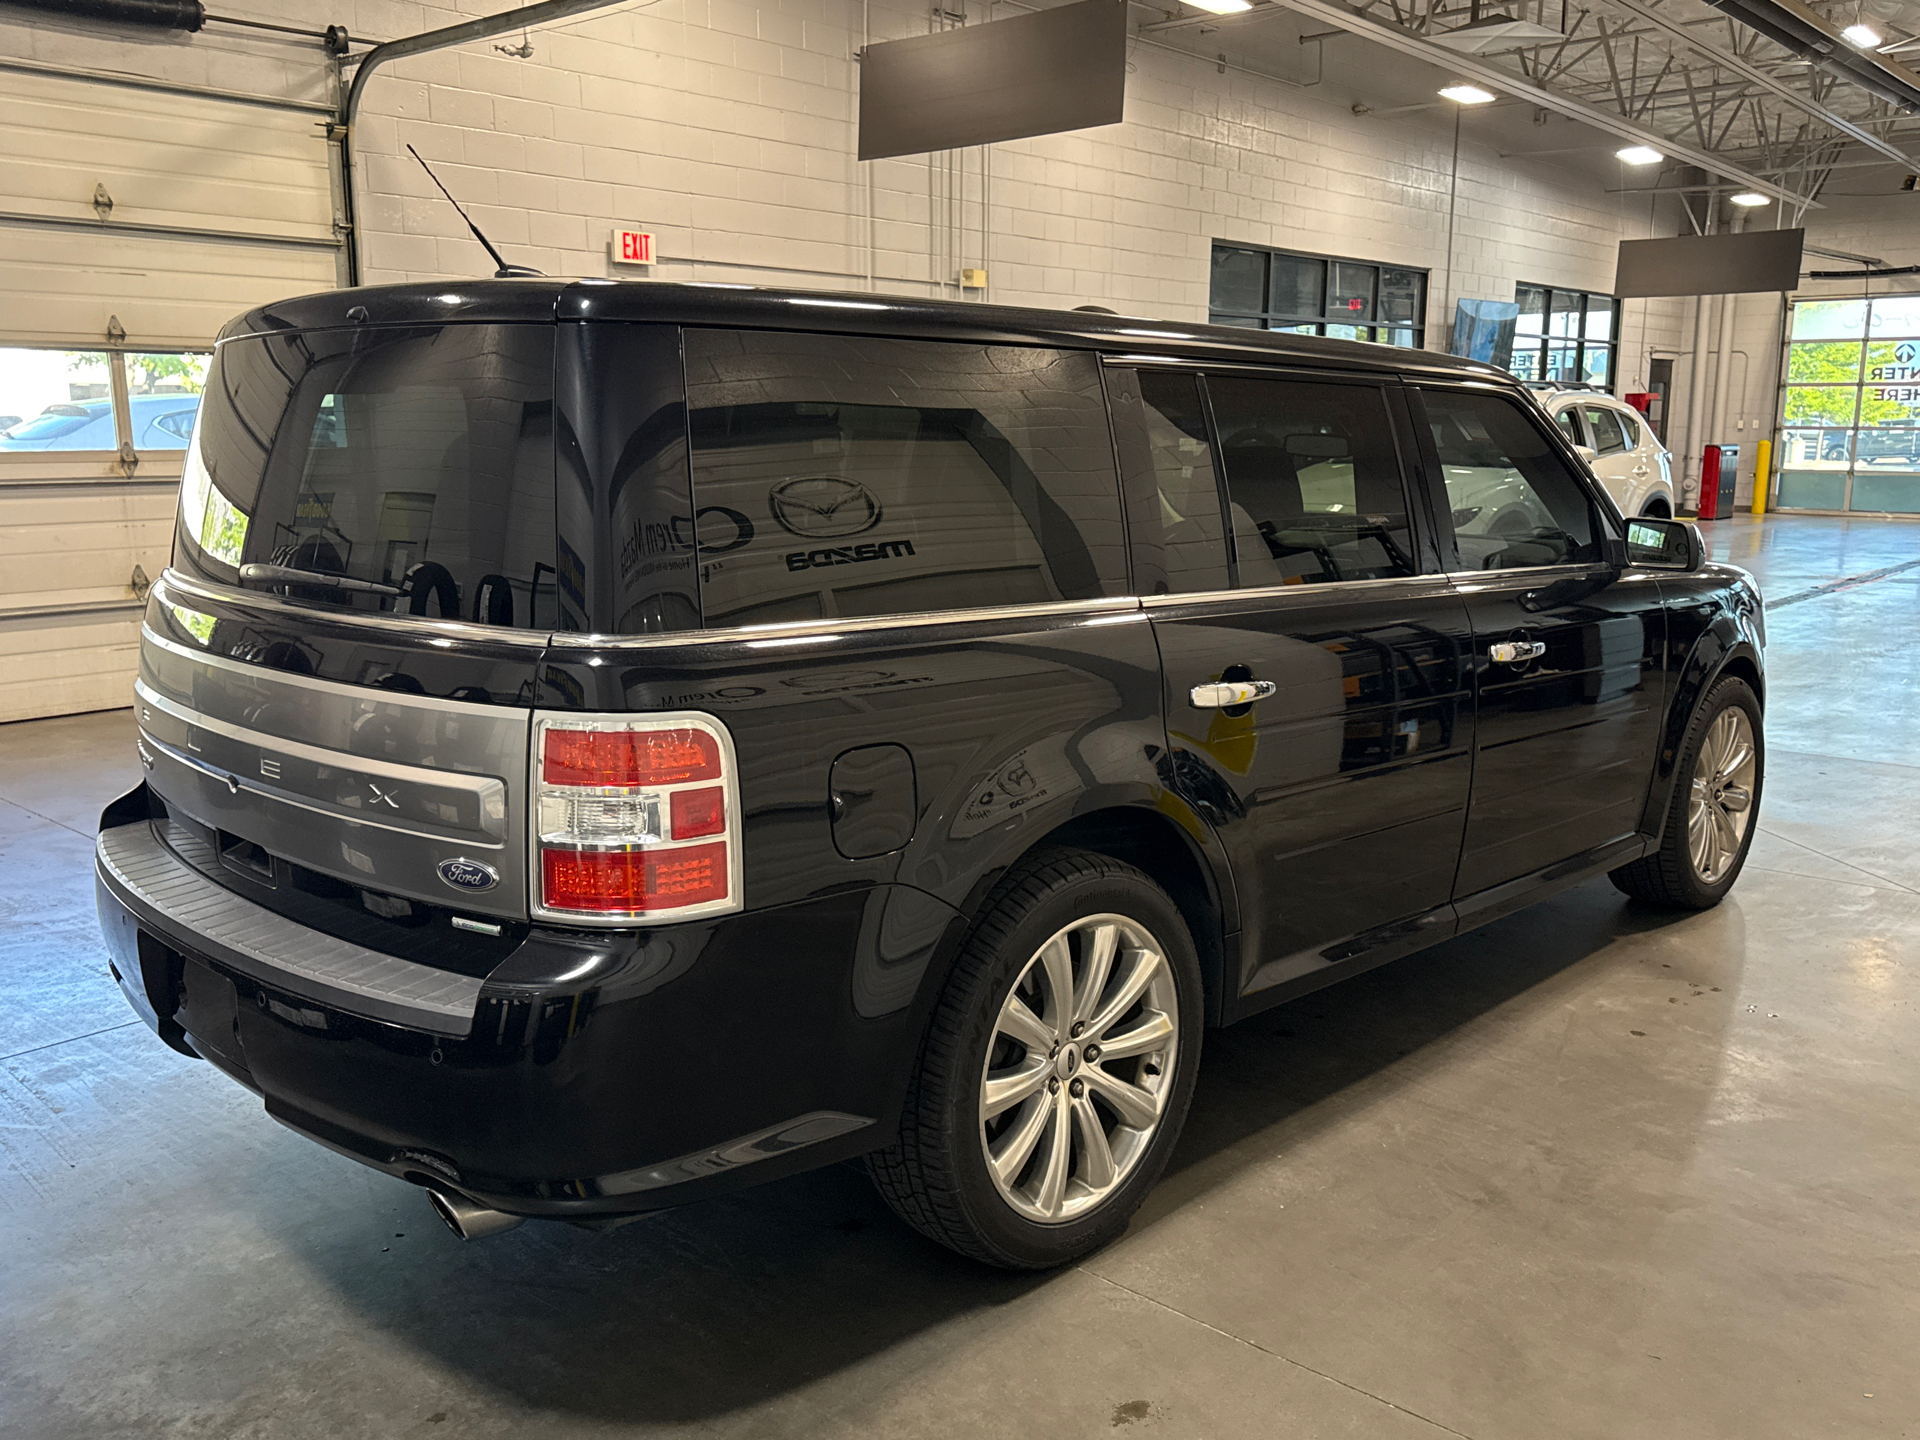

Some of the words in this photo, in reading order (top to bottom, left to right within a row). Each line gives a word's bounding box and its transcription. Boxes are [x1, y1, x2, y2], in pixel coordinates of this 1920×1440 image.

[622, 232, 651, 261] EXIT
[141, 706, 400, 809] FLEX
[447, 863, 483, 886] Ford
